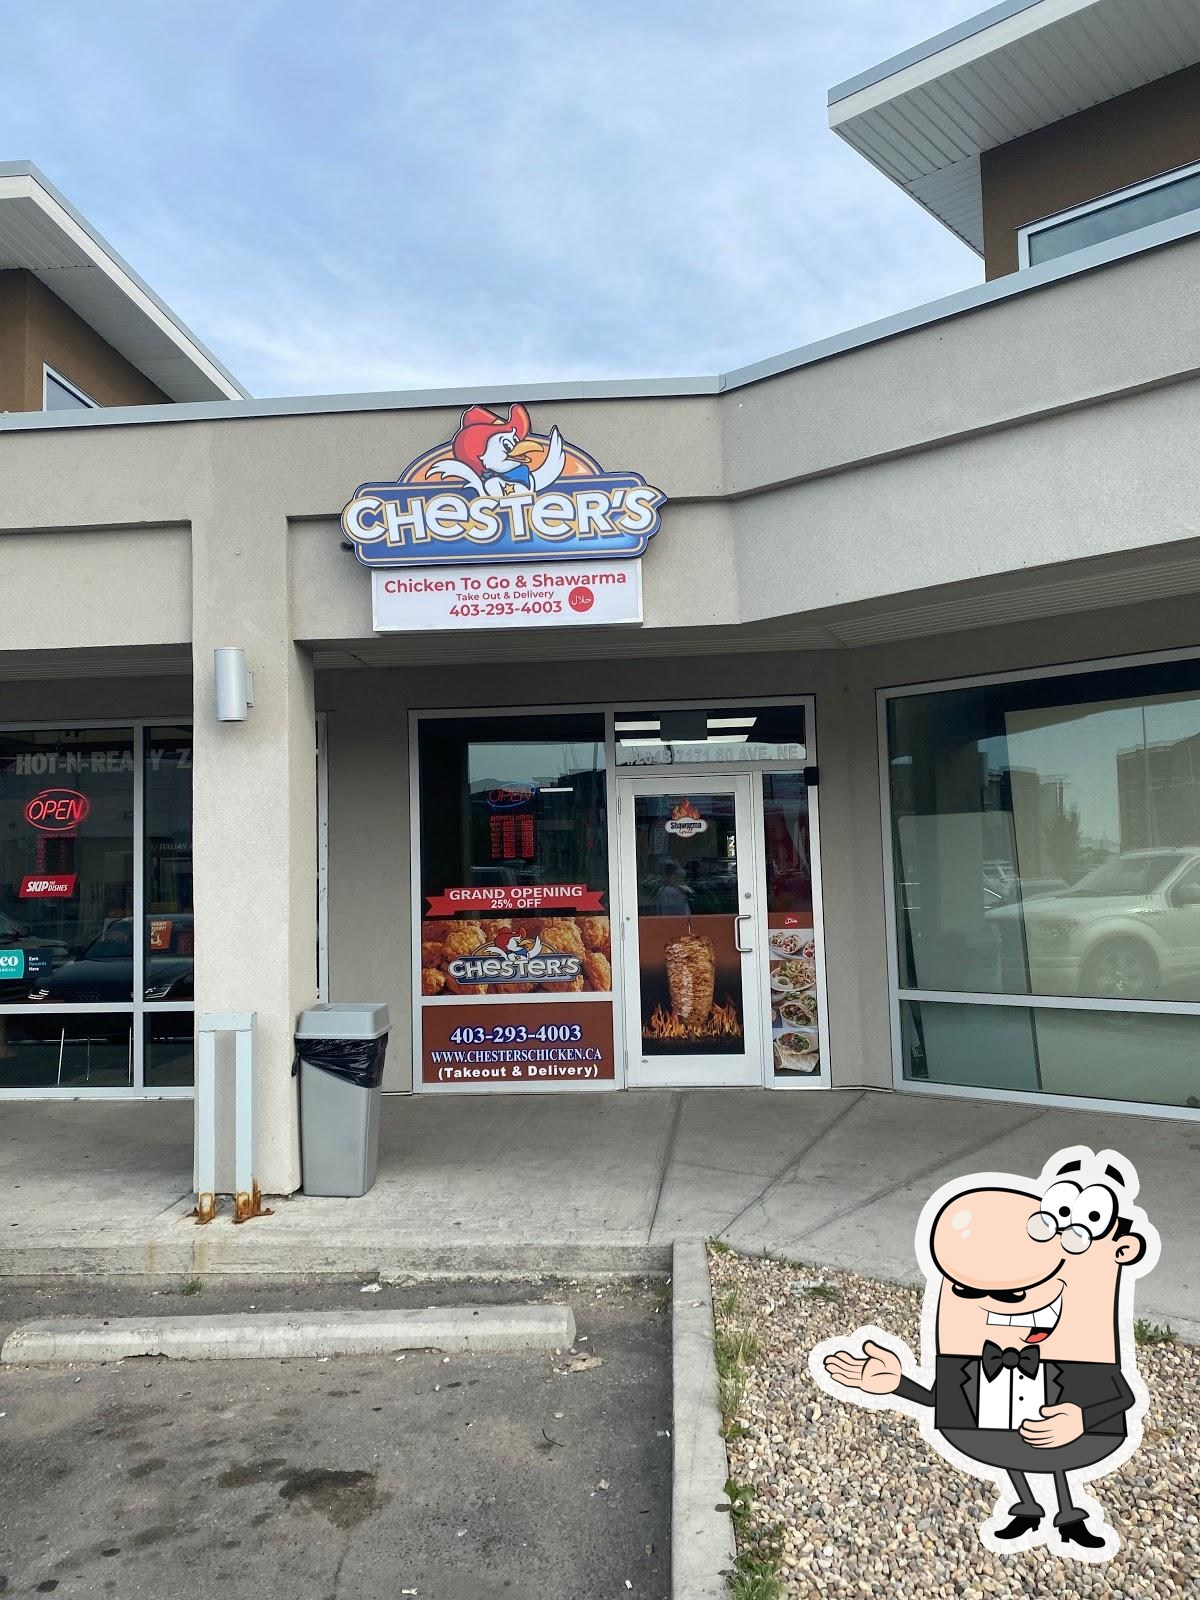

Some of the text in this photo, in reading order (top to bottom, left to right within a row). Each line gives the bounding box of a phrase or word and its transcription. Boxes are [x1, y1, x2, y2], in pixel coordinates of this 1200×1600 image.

[384, 573, 627, 593] Chicken To Go & Shawarma
[456, 590, 554, 602] Take Out & Delivery
[449, 600, 562, 617] 403-293-4003
[15, 749, 165, 775] HOT-N-REAY
[488, 786, 533, 802] OPEN
[27, 799, 84, 821] OPEN
[26, 881, 50, 893] SKIP
[449, 886, 583, 901] GRAND OPENING
[491, 899, 541, 909] 25% OFF
[450, 1024, 582, 1044] 403-293-4003
[431, 1047, 602, 1063] WWW.CHESTERSCHICKEN.CA
[438, 1064, 598, 1080] (Takeout & Delivery)
